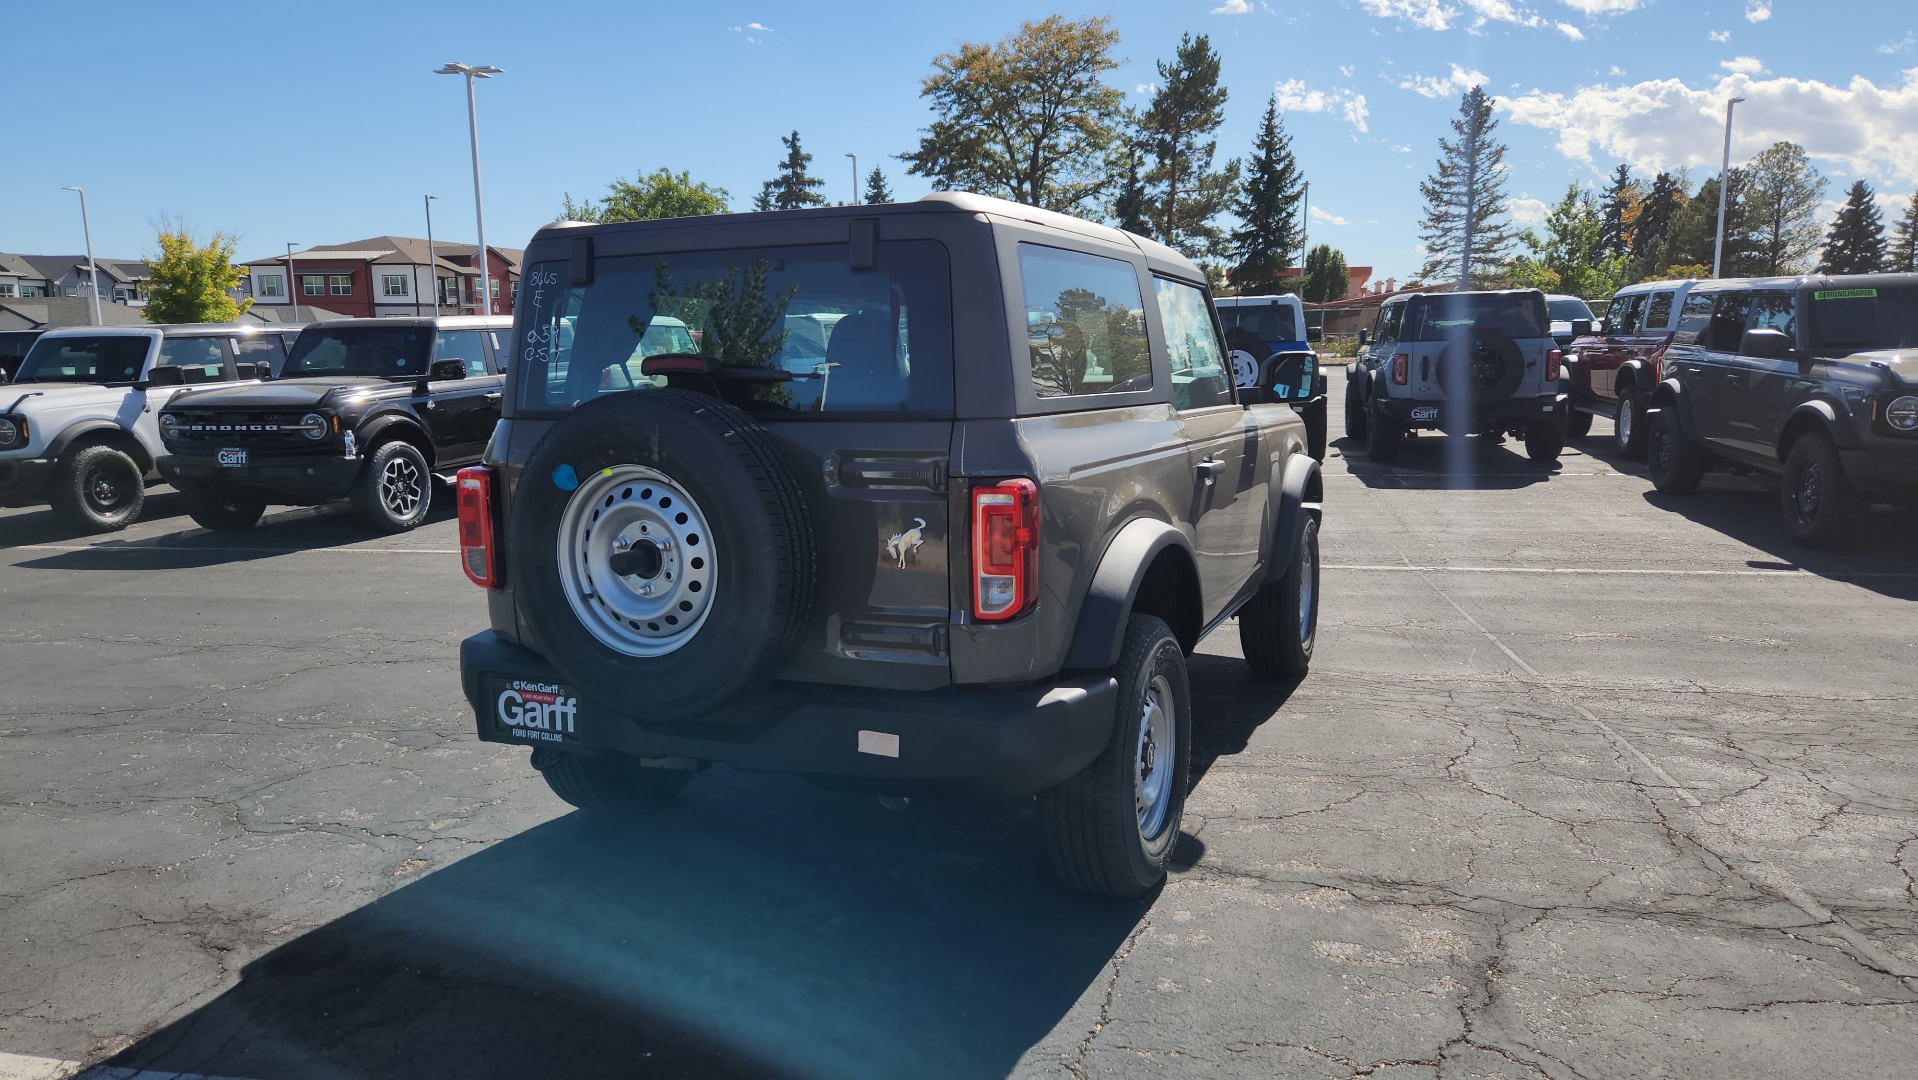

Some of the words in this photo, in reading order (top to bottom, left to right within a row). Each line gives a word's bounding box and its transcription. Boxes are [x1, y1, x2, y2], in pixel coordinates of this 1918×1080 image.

[1818, 289, 1873, 298] DEMONSTRATOR
[1411, 408, 1438, 418] Garff
[217, 451, 247, 464] Garff
[520, 681, 537, 692] Ken
[537, 683, 559, 694] Garff
[498, 690, 577, 732] Garff
[512, 728, 526, 738] FORD
[527, 730, 541, 740] FORT
[541, 732, 563, 743] COLLINS
